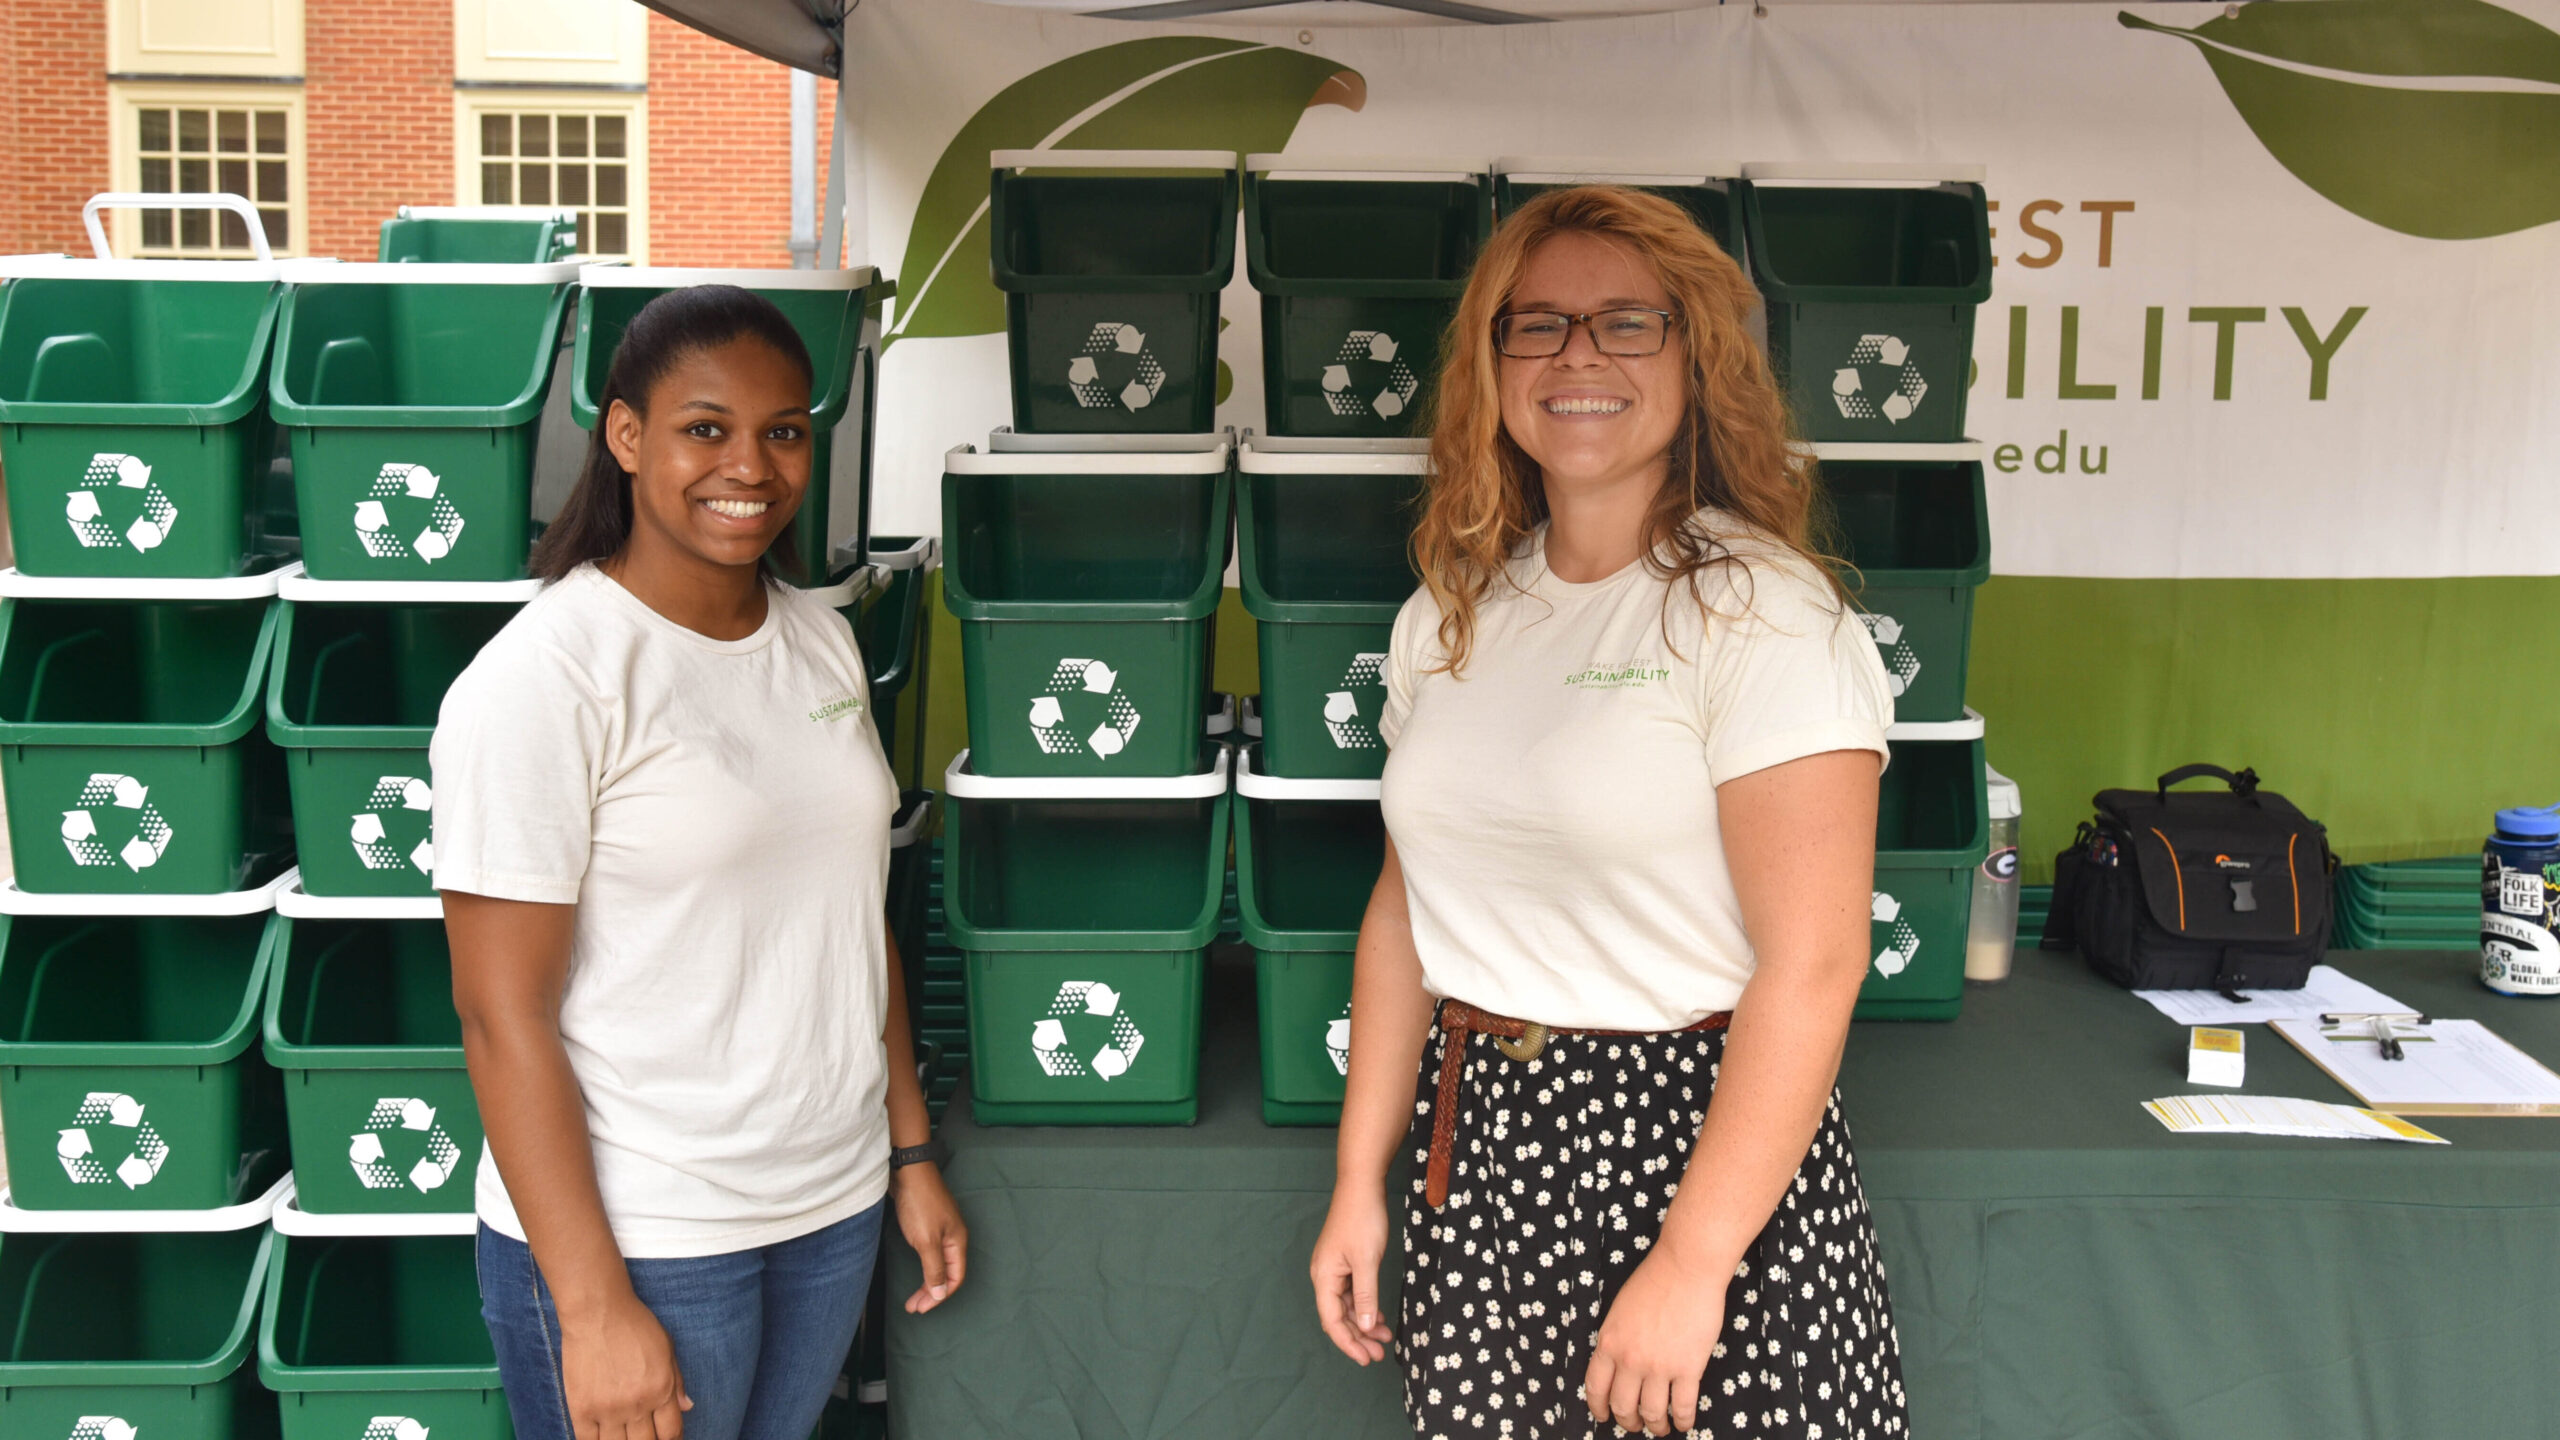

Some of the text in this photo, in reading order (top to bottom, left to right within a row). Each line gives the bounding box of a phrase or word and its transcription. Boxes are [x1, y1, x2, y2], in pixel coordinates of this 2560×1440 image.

[1969, 305, 2369, 401] ILITY
[1993, 429, 2108, 475] edu
[1564, 668, 1670, 685] SUSTAINABILITY
[2504, 878, 2538, 892] FOLK
[2504, 892, 2539, 909] LIFE
[2511, 963, 2541, 975] GLOBAL
[2511, 974, 2532, 985] WAKE
